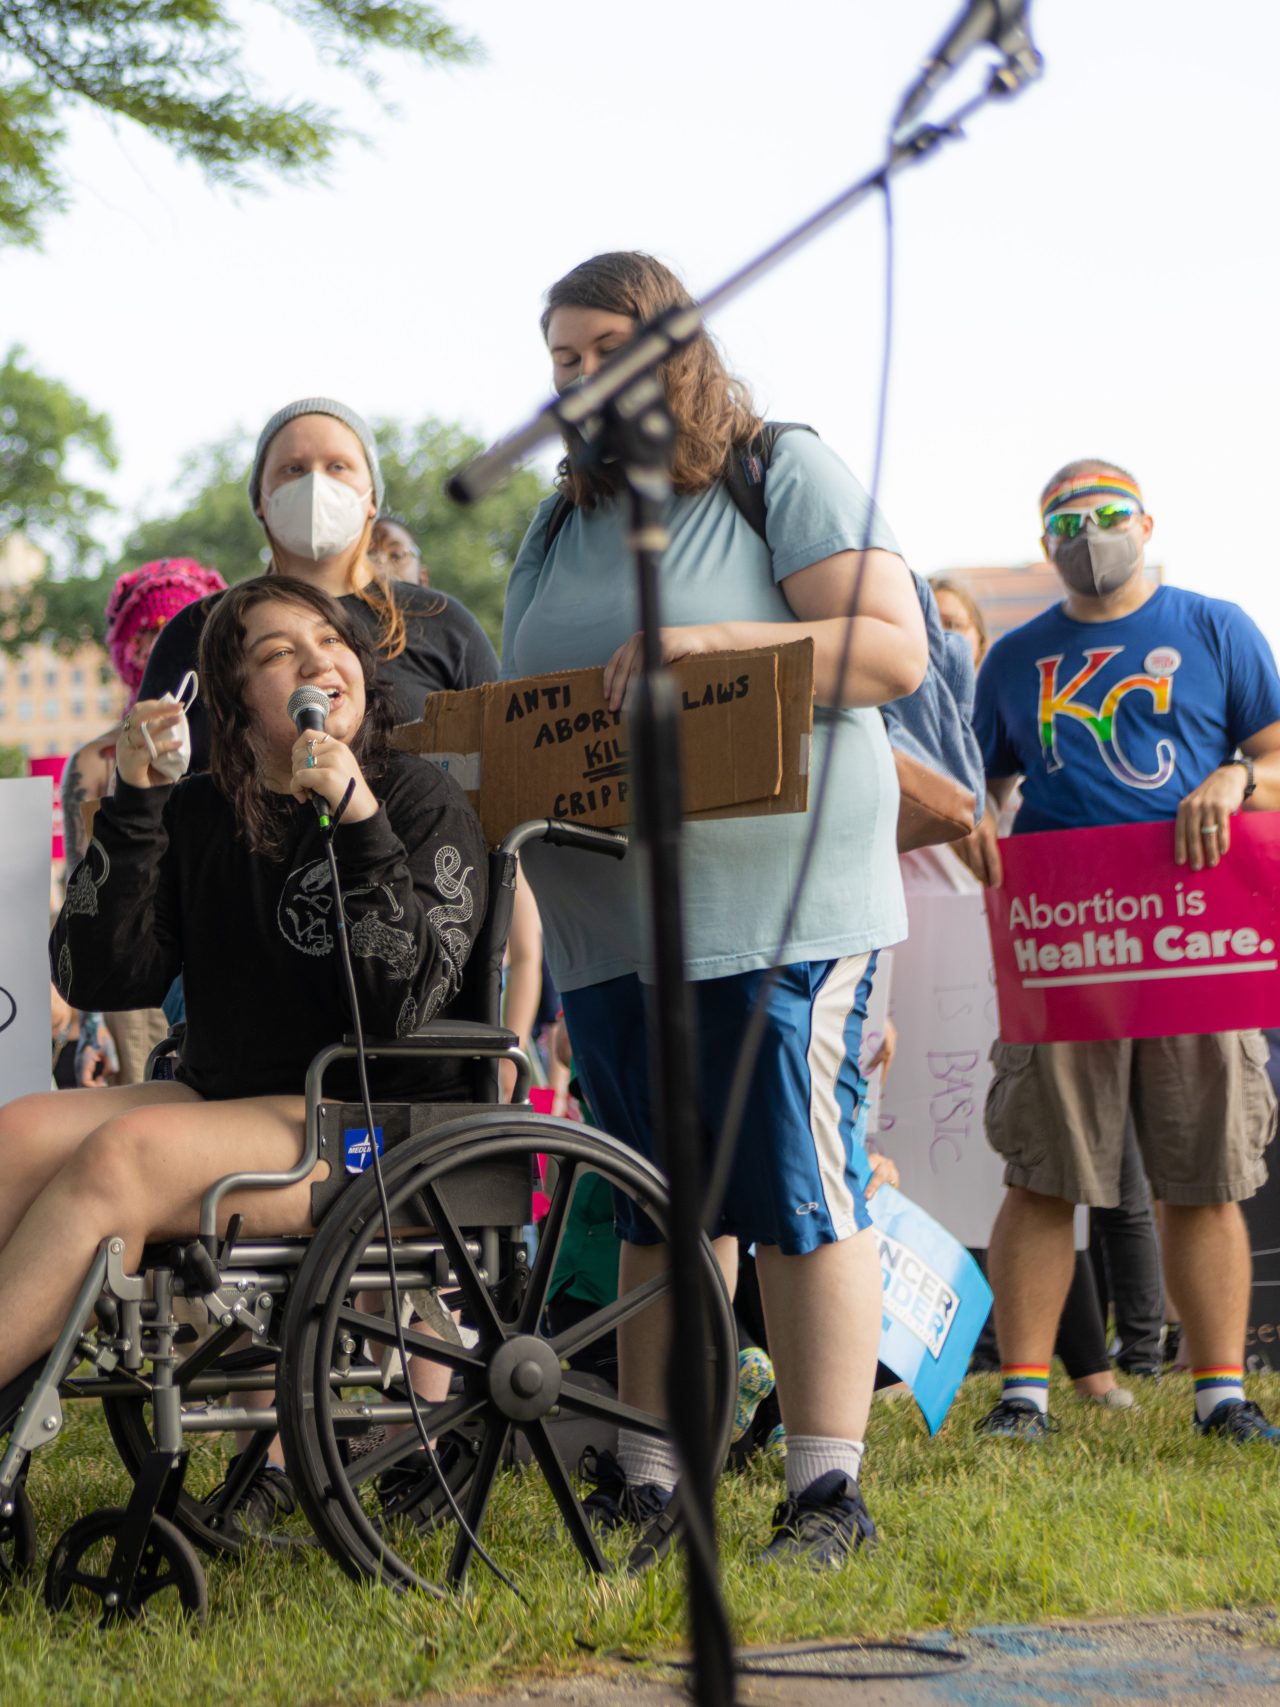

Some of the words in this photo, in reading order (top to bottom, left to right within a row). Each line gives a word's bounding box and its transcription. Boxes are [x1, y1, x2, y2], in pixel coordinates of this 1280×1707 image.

[505, 684, 571, 723] ANTI
[682, 674, 749, 711] LAWS
[534, 708, 622, 748] ABORT
[584, 738, 631, 769] KIL
[553, 781, 628, 818] CRIPP
[1009, 887, 1164, 931] Abortion
[1174, 881, 1207, 917] is
[1013, 928, 1143, 973] Health
[1153, 925, 1275, 962] Care.
[925, 1050, 979, 1176] BASIC
[879, 1239, 954, 1319] NCER
